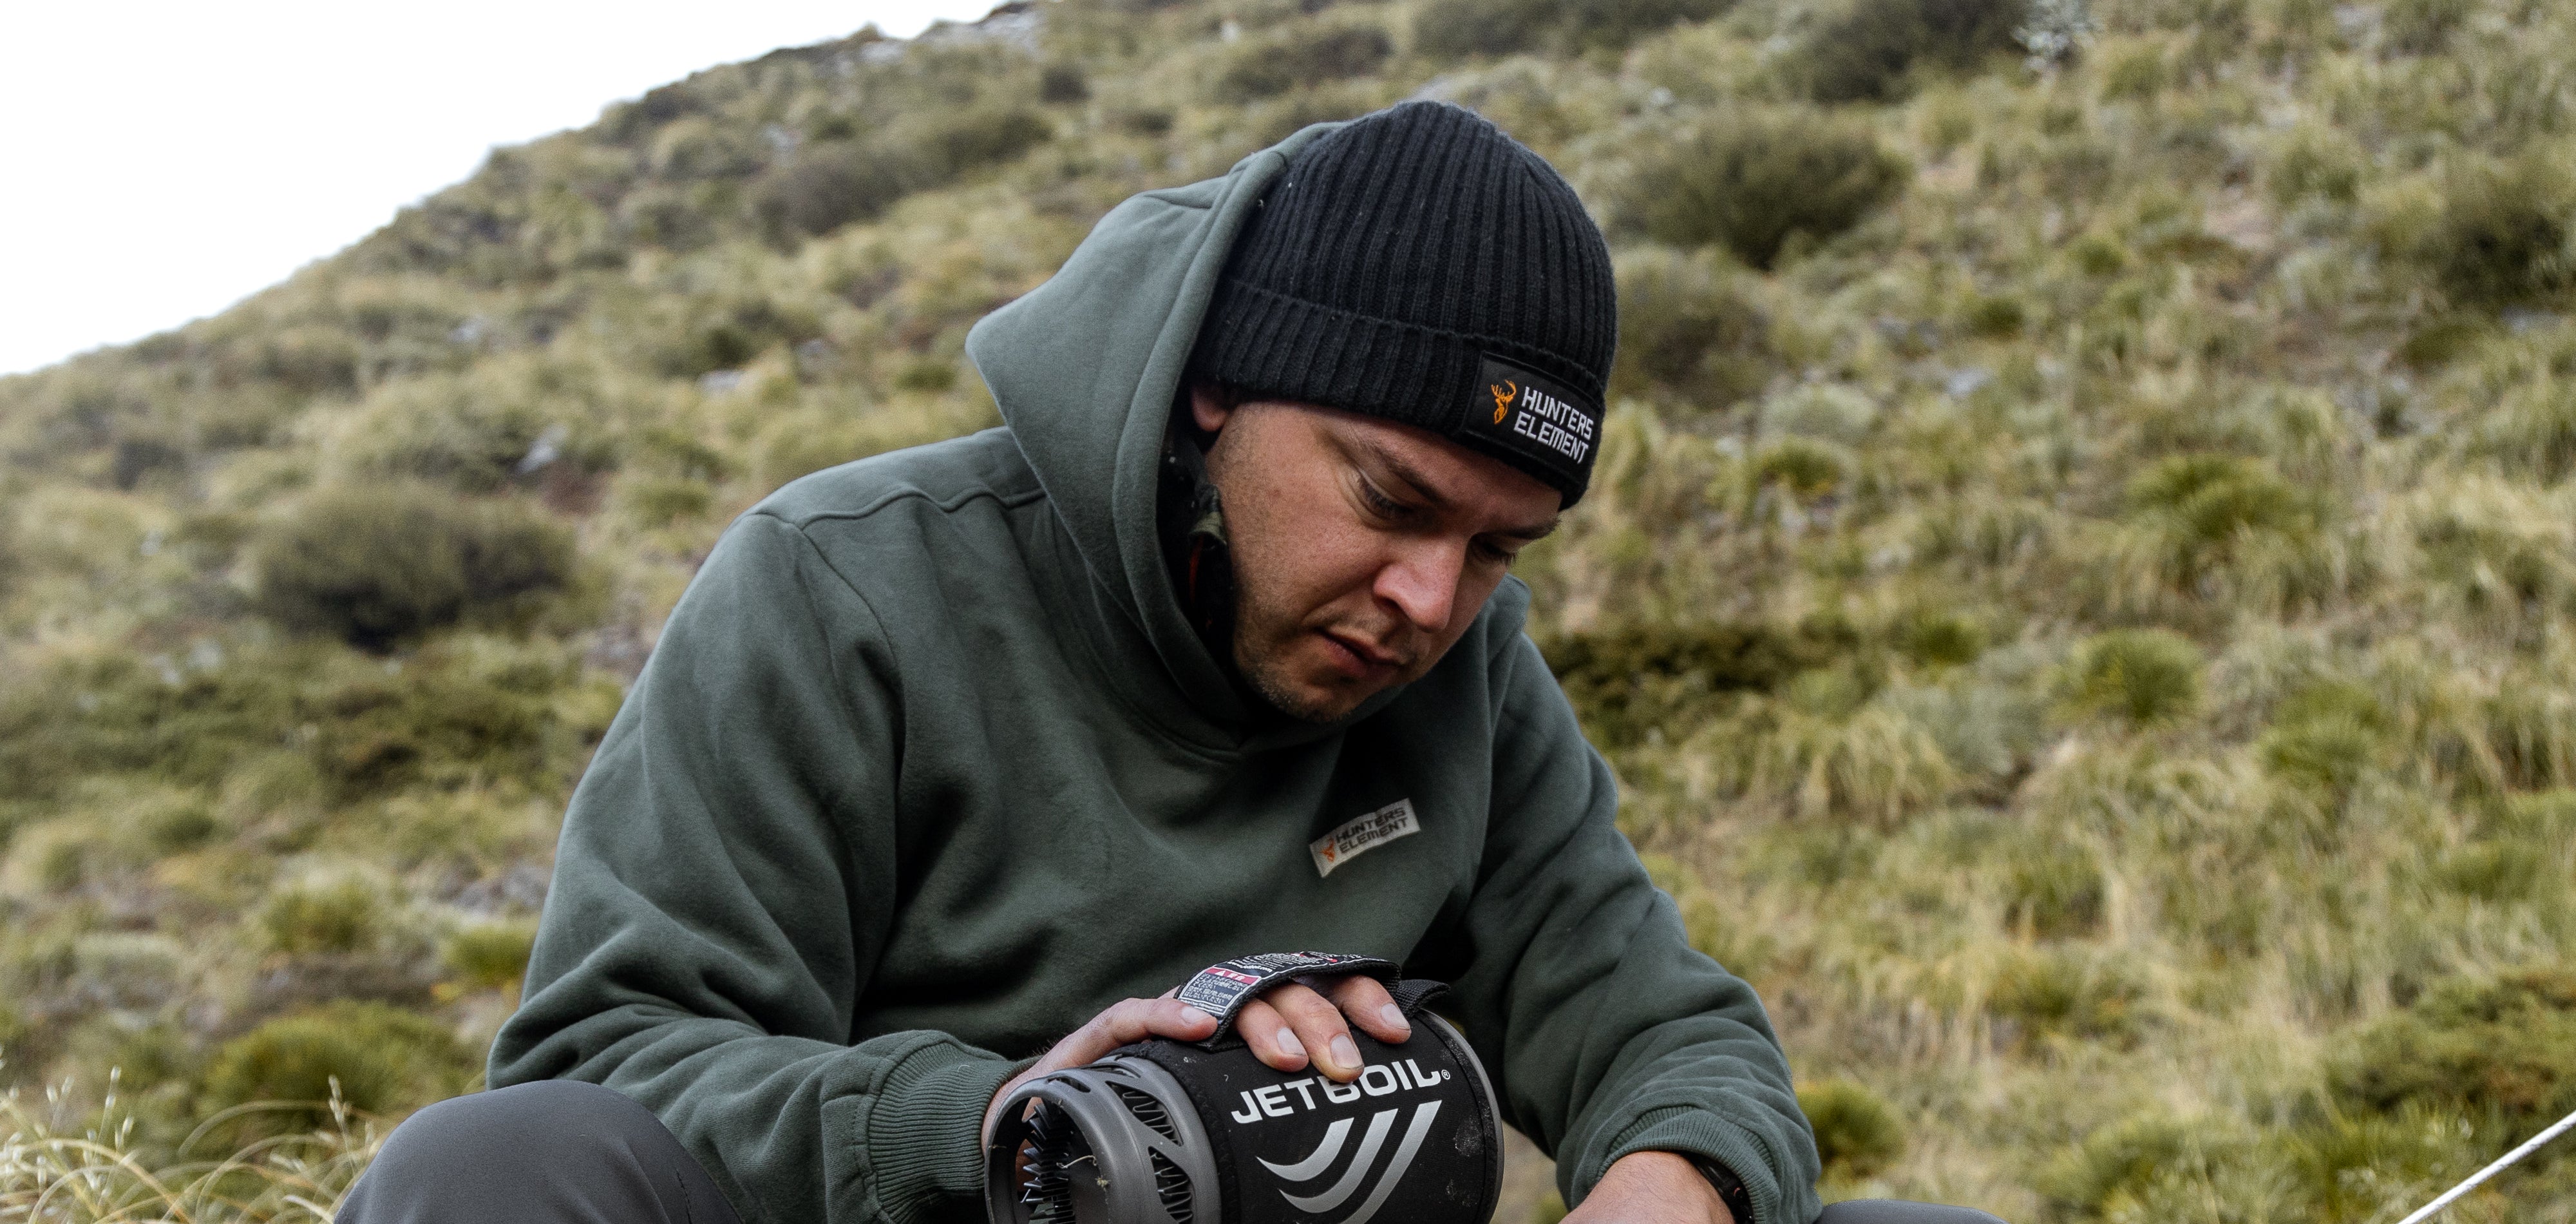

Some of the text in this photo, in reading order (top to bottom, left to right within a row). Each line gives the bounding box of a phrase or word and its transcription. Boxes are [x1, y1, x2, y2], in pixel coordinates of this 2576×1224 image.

[1522, 387, 1594, 440] HUNTERS
[1514, 411, 1589, 464] ELEMENT
[1336, 807, 1405, 843] HUNTERS
[1339, 818, 1408, 854] ELEMENT
